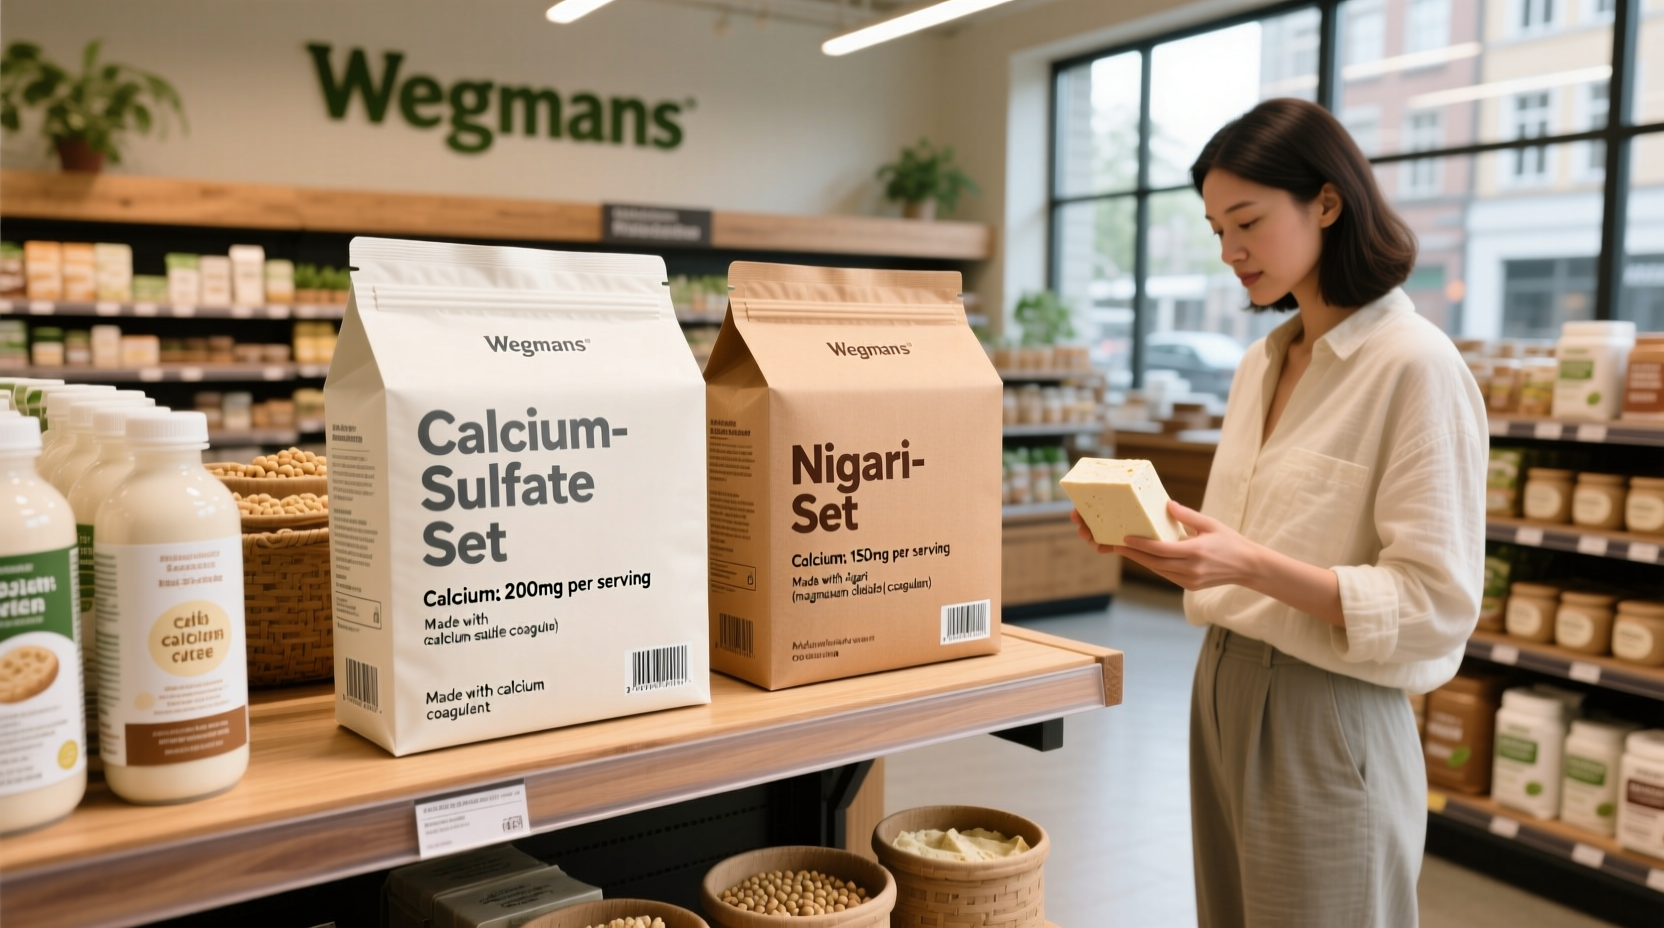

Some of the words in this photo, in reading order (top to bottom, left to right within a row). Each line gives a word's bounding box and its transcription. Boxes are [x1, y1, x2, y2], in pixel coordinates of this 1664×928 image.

[306, 43, 684, 154] Wegmans
[483, 335, 587, 357] Wegmans
[826, 341, 911, 360] Wegmans
[418, 407, 628, 456] Calcium-
[792, 438, 925, 494] Nigari-
[421, 461, 595, 512] Sulfate
[791, 493, 859, 534] Set
[422, 520, 508, 567] Set
[791, 551, 847, 568] Calcium:
[892, 548, 910, 563] per
[912, 542, 950, 557] serving
[423, 587, 502, 607] Calcium:
[504, 580, 563, 599] 200mg
[568, 578, 594, 597] per
[597, 570, 651, 589] serving
[424, 615, 460, 630] Made
[462, 612, 489, 627] with
[426, 688, 463, 705] Made
[465, 683, 493, 700] with
[497, 679, 545, 696] calcium
[426, 701, 491, 722] coagulent
